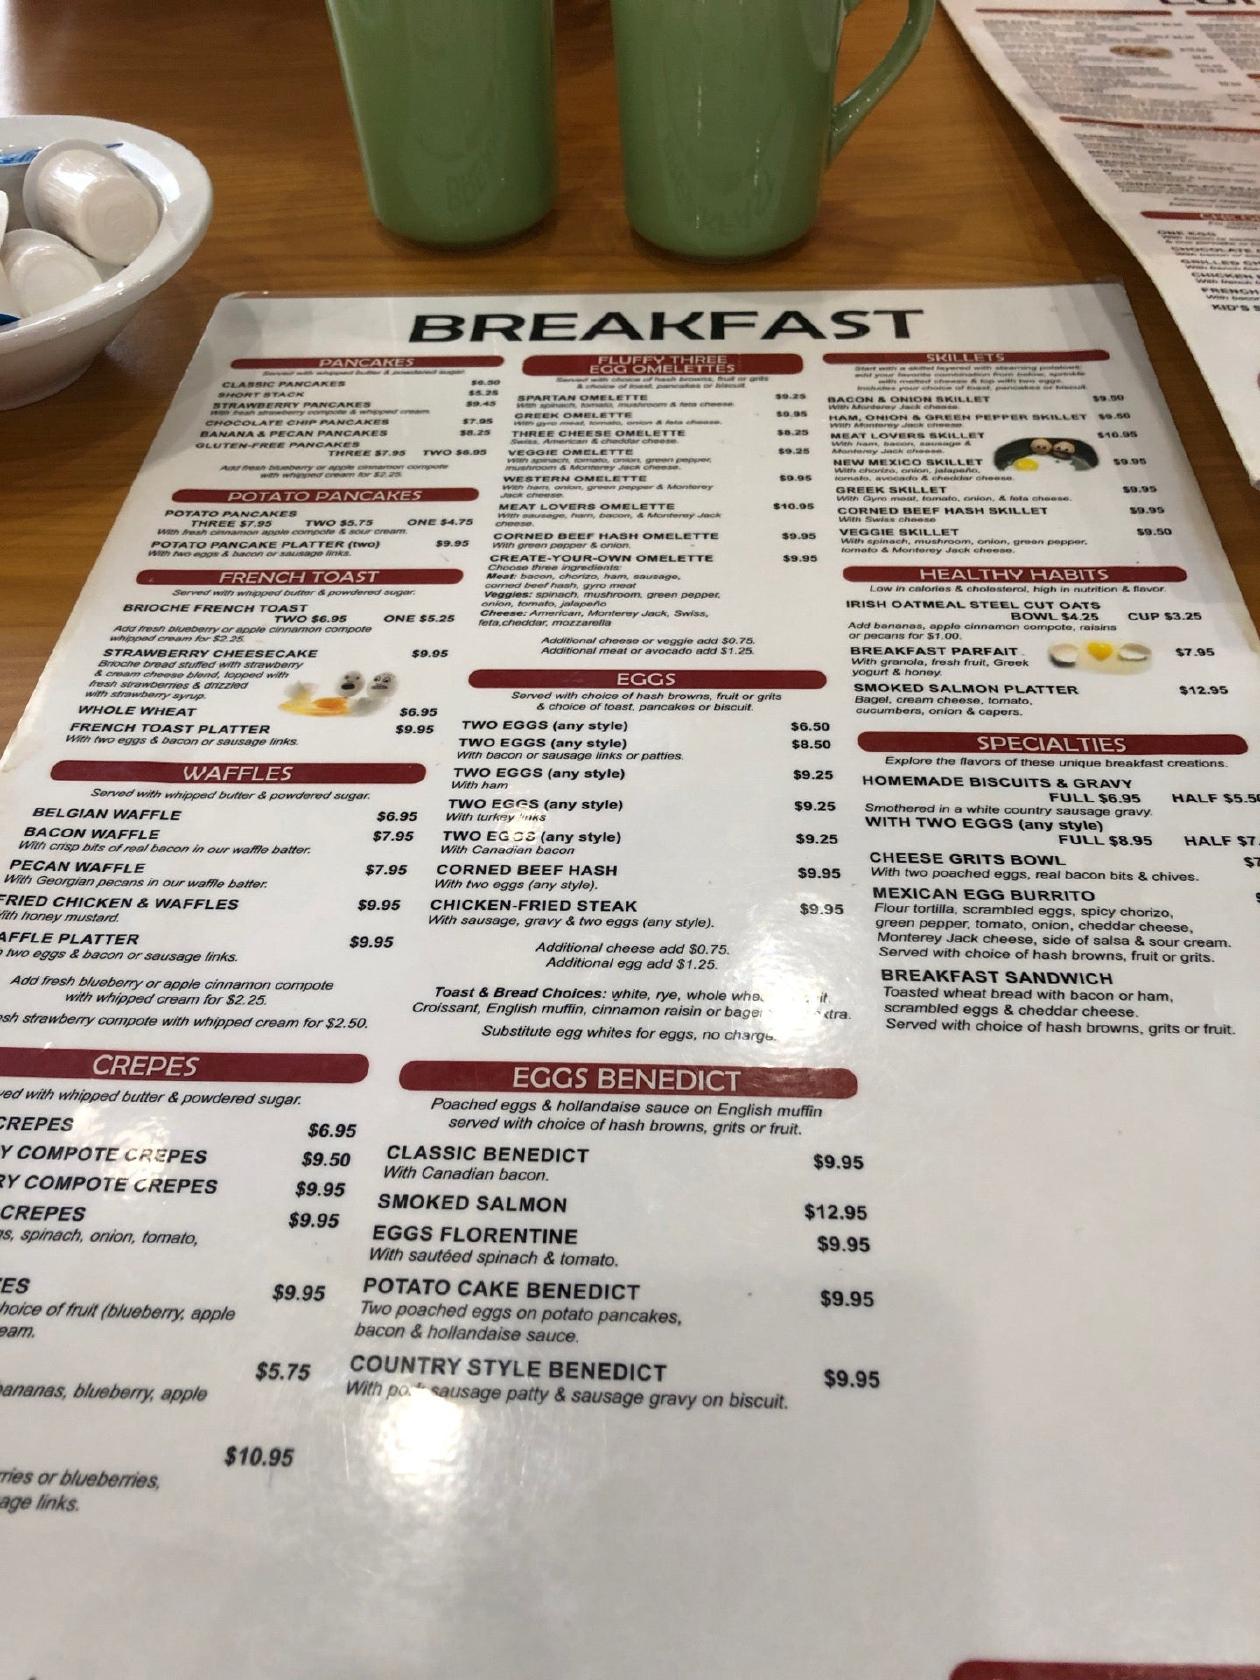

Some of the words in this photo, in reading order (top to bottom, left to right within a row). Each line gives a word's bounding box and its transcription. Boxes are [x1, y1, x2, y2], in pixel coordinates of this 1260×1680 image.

[410, 310, 925, 343] BREAKFAST
[319, 357, 417, 368] PANCAKES
[598, 356, 665, 365] FLUFFY
[671, 356, 726, 364] THREE
[926, 353, 1004, 362] SKILLETS
[590, 365, 627, 374] EGG
[632, 364, 734, 374] OMELETTES
[221, 381, 276, 389] CLASSIC
[278, 380, 346, 388] PANCAKES
[217, 391, 261, 399] SHORT
[517, 394, 576, 402] SPARTAN
[1092, 394, 1124, 402] $9.50
[212, 401, 300, 410] STRAWBERRY
[303, 401, 371, 410] PANCAKES
[514, 412, 559, 420] GREEK
[776, 410, 808, 418] $9.95
[204, 418, 283, 428] CHOCOLATE
[199, 430, 254, 438] BANANA
[256, 430, 266, 438] &
[269, 430, 314, 438] PECAN
[460, 429, 491, 437] $8.25
[512, 430, 554, 438] THREE
[558, 430, 611, 438] CHEESE
[830, 432, 866, 440] MEAT
[1097, 430, 1138, 439] $10.95
[562, 448, 633, 456] OMELETTE
[868, 458, 922, 466] MEXICO
[926, 458, 983, 466] SKILLET
[1113, 457, 1147, 466] $9.95
[779, 474, 812, 482] $9.95
[836, 486, 885, 494] GREEK
[889, 486, 947, 494] SKILLET
[1122, 485, 1158, 494] $9.95
[228, 491, 310, 502] POTATO
[315, 490, 422, 501] PANCAKES
[773, 502, 814, 510] $10.95
[837, 507, 899, 515] CORNED
[902, 507, 940, 515] BEEF
[944, 507, 984, 515] HASH
[988, 507, 1048, 515] SKILLET
[1129, 506, 1165, 514] $9.95
[493, 532, 554, 540] CORNED
[557, 532, 594, 540] BEEF
[598, 532, 638, 540] HASH
[642, 532, 719, 540] OMELETTE
[782, 532, 816, 540] $9.95
[839, 528, 894, 536] VEGGIE
[899, 528, 959, 536] SKILLET
[1136, 528, 1172, 536] $9.50
[149, 539, 207, 549] POTATO
[210, 540, 277, 549] PANCAKE
[281, 540, 344, 549] PLATTER
[347, 540, 381, 550] (two)
[436, 540, 469, 548] $9.95
[490, 554, 632, 562] CREATE-YOUR-OWN
[636, 554, 713, 562] OMELETTE
[783, 554, 818, 563] $9.95
[219, 571, 306, 584] FRENCH
[312, 571, 380, 583] TOAST
[920, 569, 1023, 580] HEALTHY
[1030, 569, 1108, 580] HABITS
[122, 604, 190, 612] BRIOCHE
[193, 604, 255, 613] FRENCH
[260, 604, 308, 613] TOAST
[846, 600, 886, 608] IRISH
[891, 600, 966, 609] OATMEAL
[969, 600, 1020, 609] STEEL
[1024, 601, 1054, 610] CUT
[1059, 601, 1101, 610] OATS
[541, 636, 597, 645] Additional
[598, 637, 640, 645] cheese
[656, 637, 694, 647] veggie
[696, 637, 719, 645] add
[721, 637, 755, 646] $0.75.
[103, 648, 210, 658] STRAWBERRY
[213, 649, 318, 658] CHEESECAKE
[411, 649, 448, 658] $9.95
[617, 673, 676, 686] EGGS
[854, 683, 924, 693] SMOKED
[928, 684, 999, 694] SALMON
[1004, 684, 1079, 695] PLATTER
[1179, 685, 1228, 696] $12.95
[78, 705, 136, 715] WHOLE
[140, 706, 197, 717] WHEAT
[399, 707, 438, 717] $6.95
[977, 736, 1126, 752] SPECIALTIES
[184, 766, 293, 781] WAFFLES
[32, 807, 109, 819] BELGIAN
[113, 809, 182, 821] WAFFLE
[376, 811, 418, 822] $6.95
[24, 826, 87, 838] BACON
[91, 829, 160, 840] WAFFLE
[372, 830, 414, 842] $7.95
[870, 852, 944, 864] CHEESE
[949, 853, 1005, 865] GRITS
[1010, 854, 1066, 866] BOWL
[436, 864, 512, 875] CORNED
[517, 864, 564, 876] BEEF
[569, 865, 618, 876] HASH
[798, 867, 841, 879] $9.95
[872, 887, 958, 900] MEXICAN
[963, 888, 1005, 900] EGG
[1010, 890, 1095, 902] BURRITO
[430, 899, 571, 912] CHICKEN-FRIED
[577, 900, 637, 912] STEAK
[800, 902, 844, 916] $9.95
[881, 969, 999, 984] BREAKFAST
[1005, 971, 1113, 985] SANDWICH
[93, 1054, 200, 1076] CREPES
[513, 1067, 588, 1088] EGGS
[598, 1068, 742, 1091] BENEDICT
[308, 1122, 357, 1138] $6.95
[387, 1144, 476, 1161] CLASSIC
[483, 1146, 590, 1163] BENEDICT
[813, 1153, 864, 1170] $9.95
[384, 1165, 417, 1179] With
[422, 1166, 494, 1180] Canadian
[498, 1168, 549, 1182] bacon.
[378, 1193, 470, 1210] SMOKED
[476, 1195, 567, 1213] SALMON
[804, 1203, 868, 1221] $12.95
[372, 1225, 433, 1242] EGGS
[440, 1226, 578, 1245] FLORENTINE
[817, 1235, 870, 1253] $9.95
[363, 1277, 451, 1296] POTATO
[458, 1280, 519, 1298] CAKE
[526, 1282, 640, 1300] BENEDICT
[820, 1289, 874, 1308] $9.95
[350, 1354, 462, 1375] COUNTRY
[467, 1358, 542, 1378] STYLE
[548, 1361, 668, 1382] BENEDICT
[824, 1368, 880, 1389] $9.95
[224, 1445, 295, 1467] $10.95
